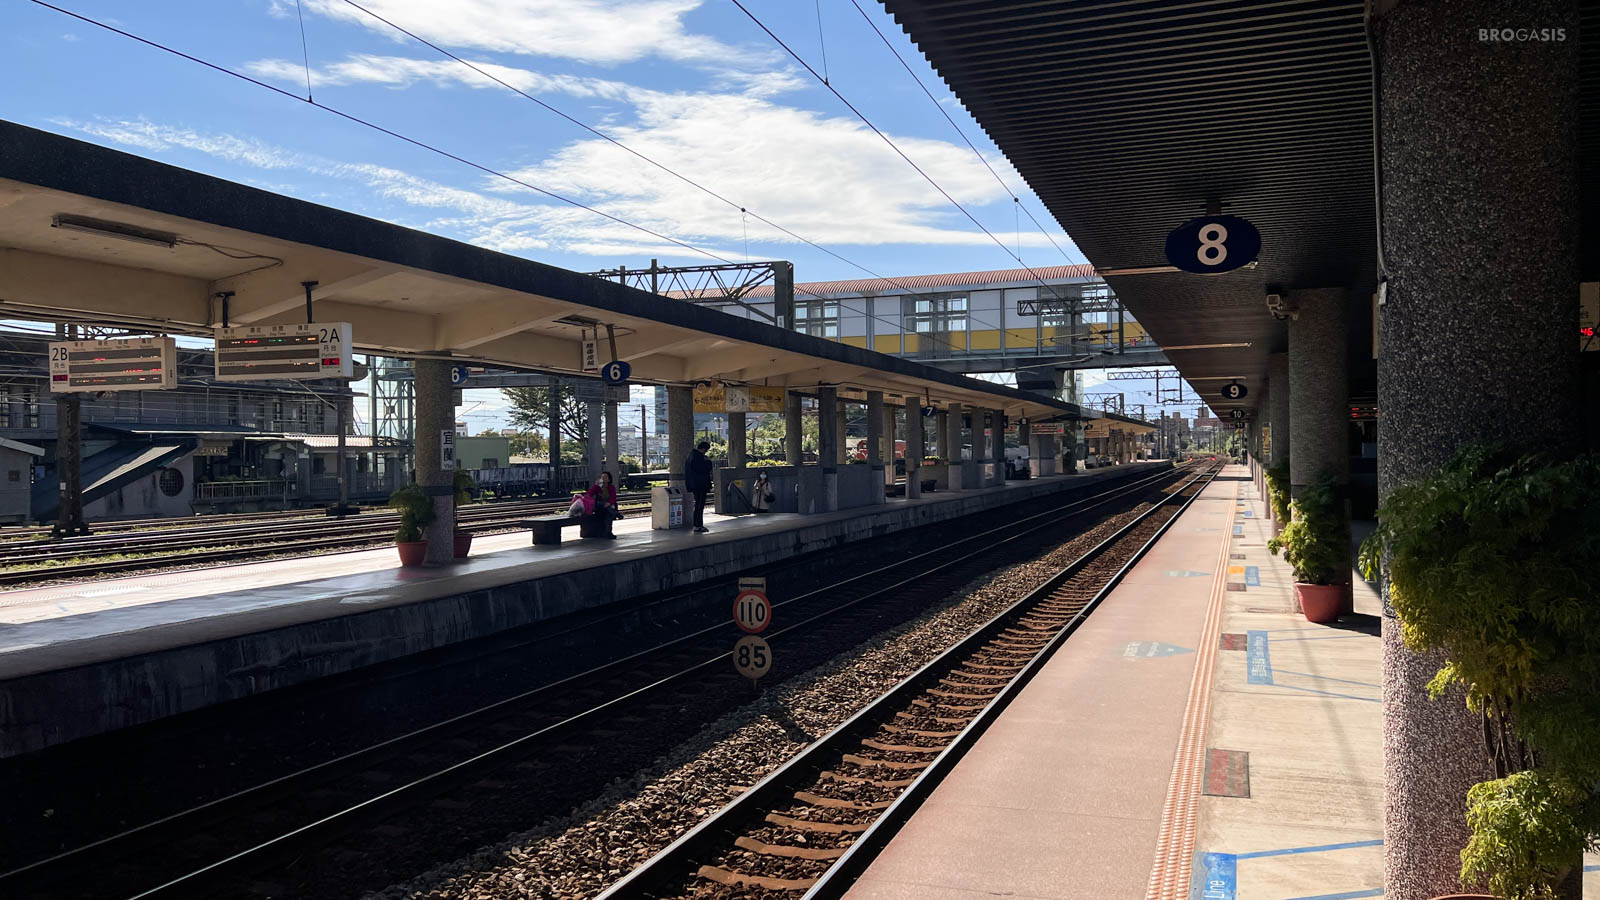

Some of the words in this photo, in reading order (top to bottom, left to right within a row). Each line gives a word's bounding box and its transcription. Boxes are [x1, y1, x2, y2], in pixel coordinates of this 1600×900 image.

[1197, 223, 1228, 266] 8
[319, 328, 340, 344] 2A
[52, 347, 68, 361] 2B
[451, 367, 460, 383] 6
[609, 363, 621, 381] 6
[1230, 385, 1240, 398] 9
[926, 406, 934, 417] 7
[1232, 410, 1242, 418] 10
[740, 601, 766, 622] 110
[738, 645, 766, 668] 85
[1204, 879, 1225, 899] Line
